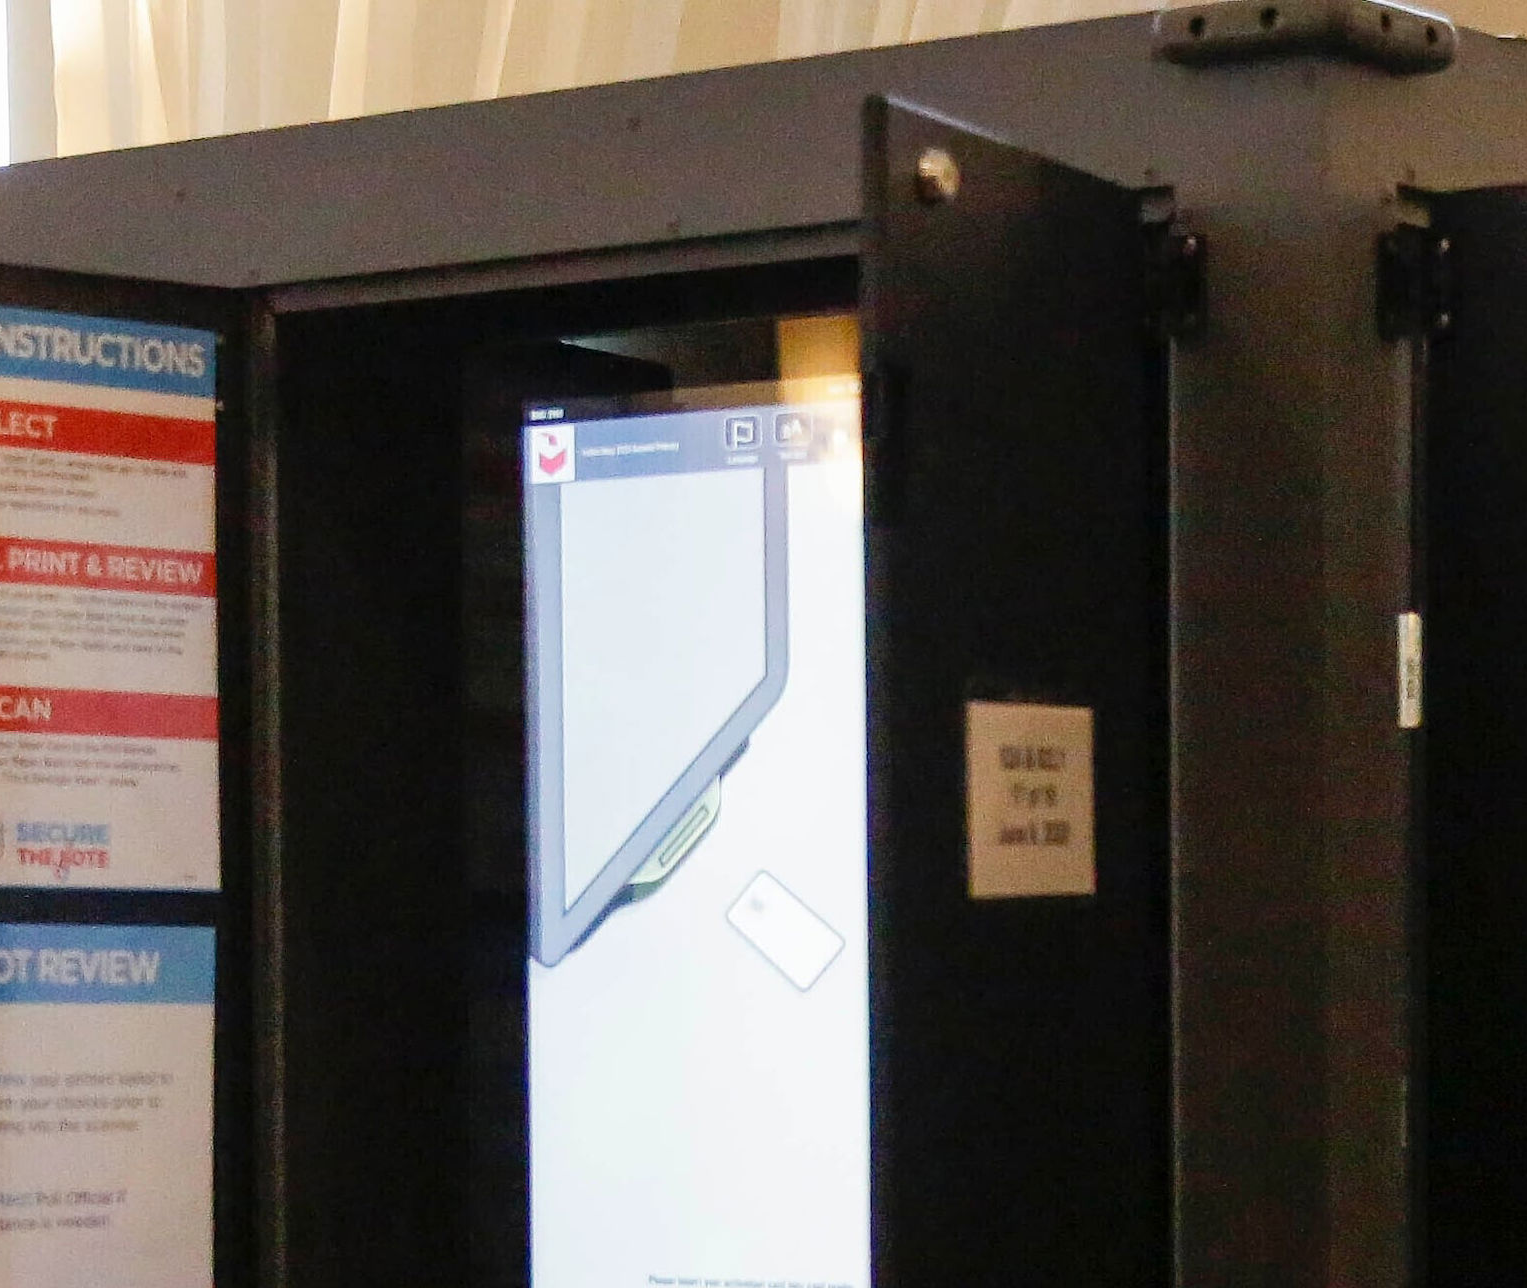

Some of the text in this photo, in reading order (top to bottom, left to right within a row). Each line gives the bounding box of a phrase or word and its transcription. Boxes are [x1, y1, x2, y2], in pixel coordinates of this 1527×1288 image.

[8, 547, 78, 575] PRINT
[85, 552, 102, 577] &
[106, 553, 204, 584] REVIEW
[15, 822, 110, 844] SECURE
[38, 949, 160, 983] REVIEW
